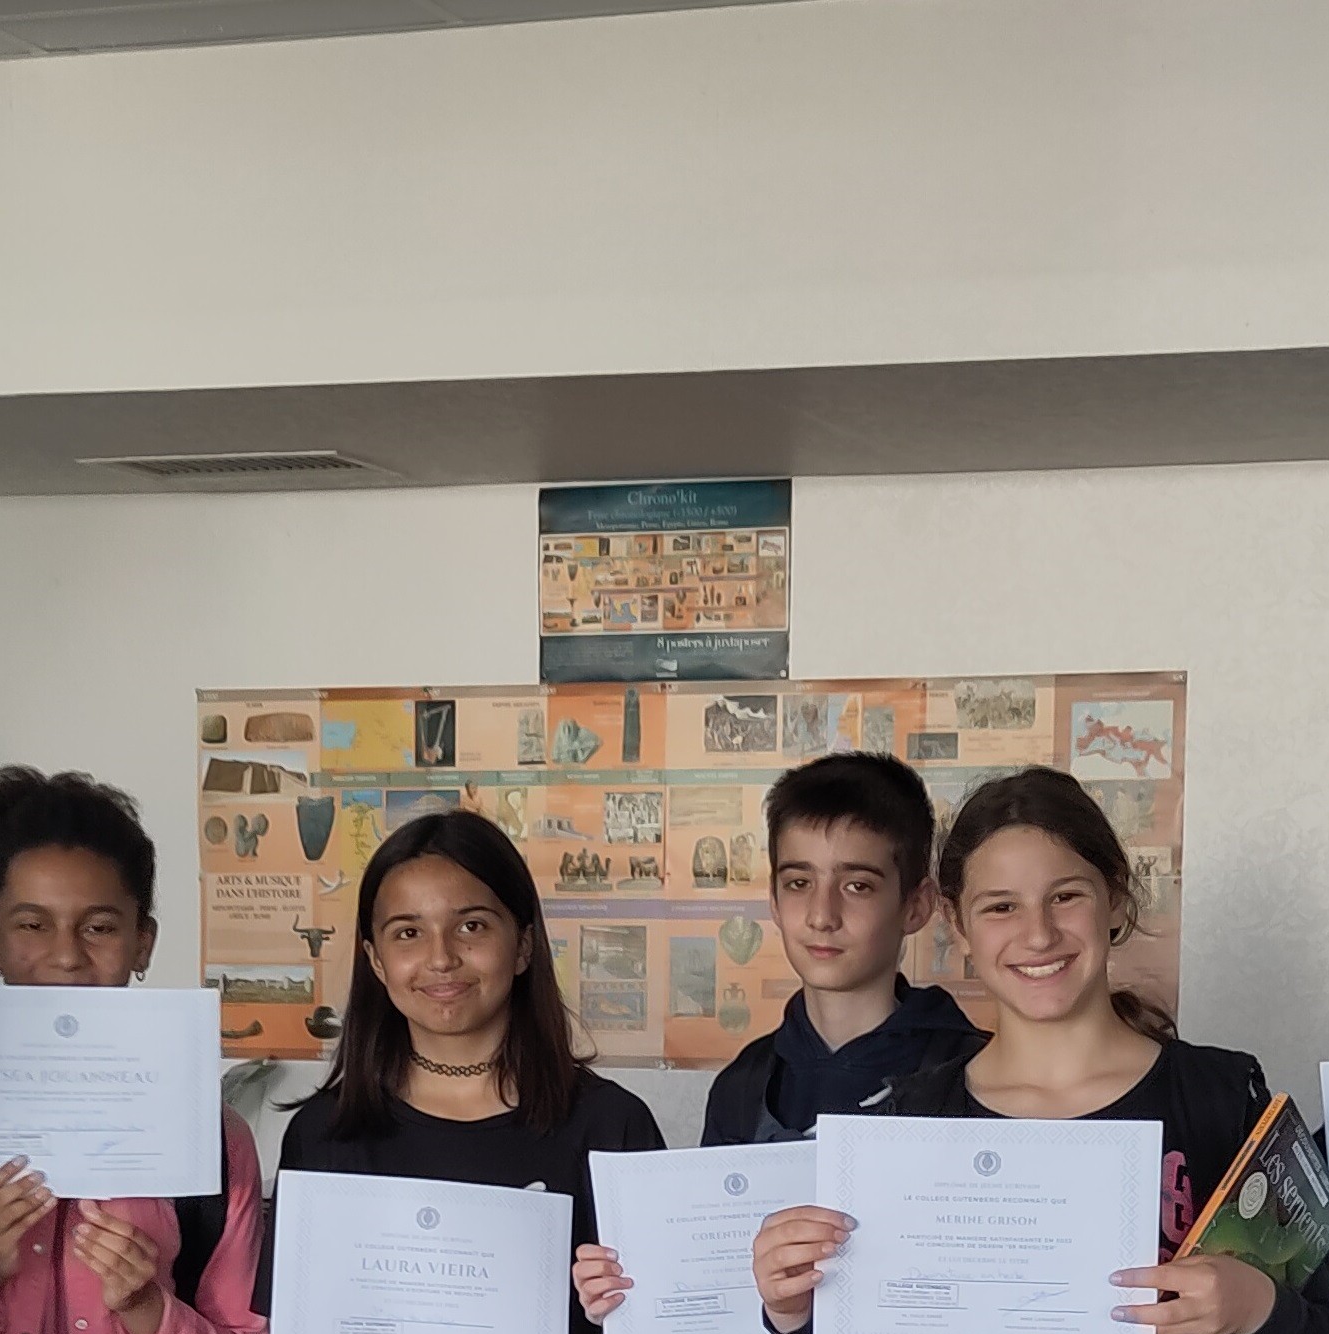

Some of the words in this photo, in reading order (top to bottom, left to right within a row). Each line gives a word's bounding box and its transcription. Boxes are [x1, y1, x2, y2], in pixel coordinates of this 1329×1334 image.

[627, 489, 698, 506] Chrono'kit
[216, 888, 244, 898] DANS
[1259, 1129, 1287, 1185] Les
[987, 1214, 1038, 1227] GRISON
[1277, 1175, 1329, 1253] serpents
[691, 1230, 751, 1242] CORENTIN
[361, 1257, 422, 1274] LAURA
[428, 1261, 489, 1279] VIEIRA
